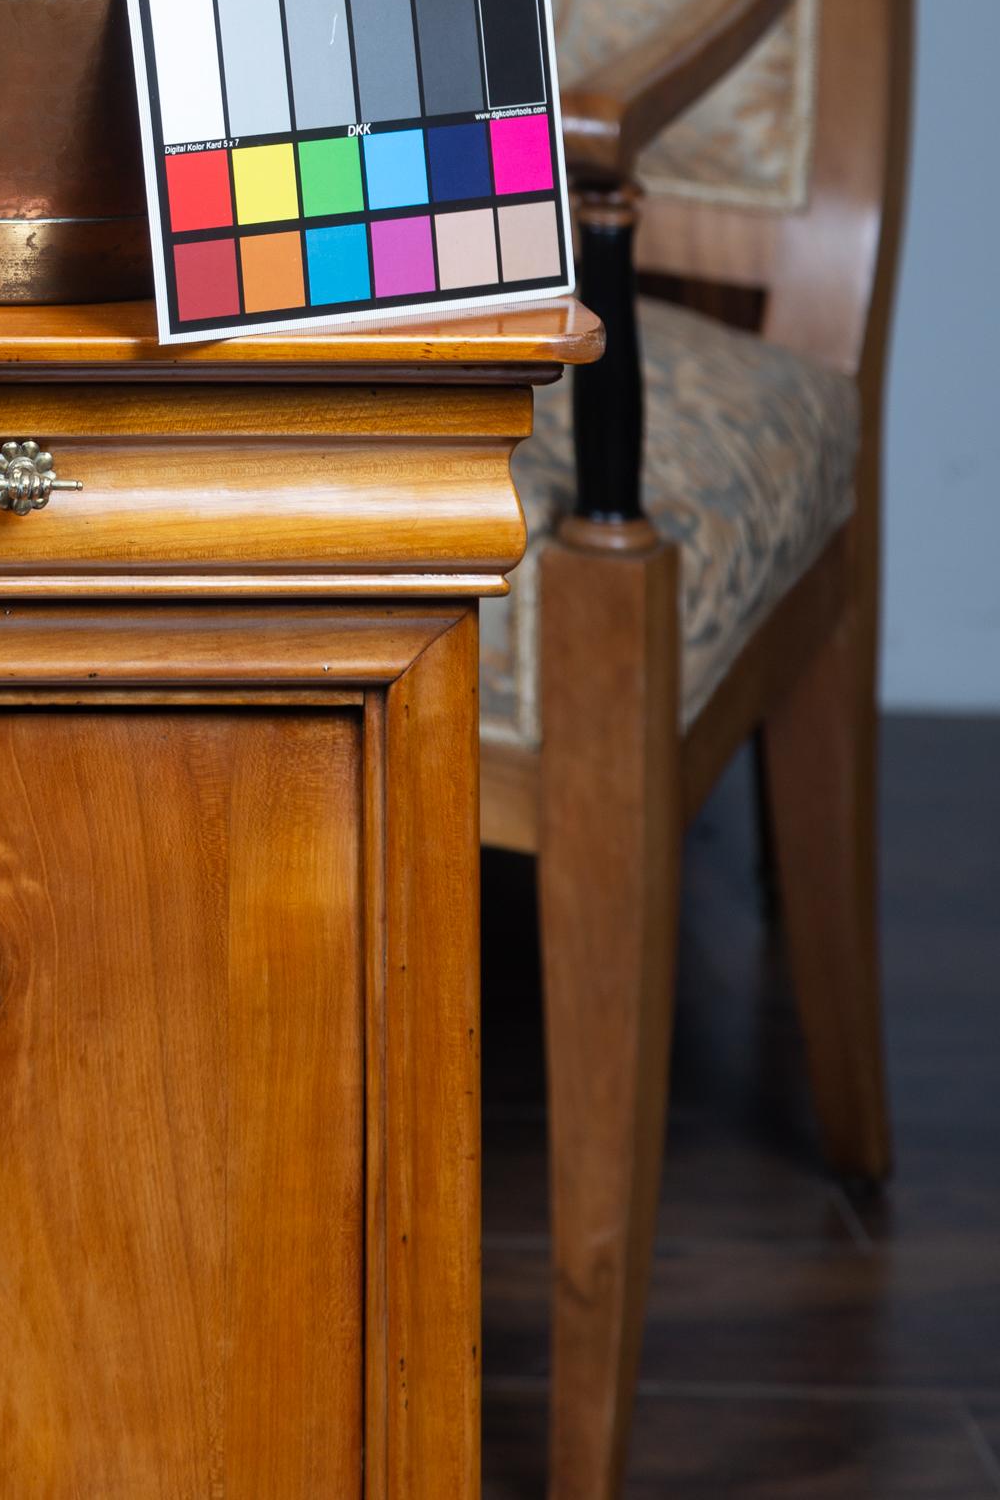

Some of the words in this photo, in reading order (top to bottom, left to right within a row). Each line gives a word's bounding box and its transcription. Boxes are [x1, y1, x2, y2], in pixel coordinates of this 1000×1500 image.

[474, 106, 547, 120] www.dgkcolortools.com
[347, 122, 372, 137] DKK
[165, 145, 186, 155] Digital
[187, 142, 205, 152] Kolor
[206, 140, 222, 150] Kard
[223, 140, 228, 148] 5
